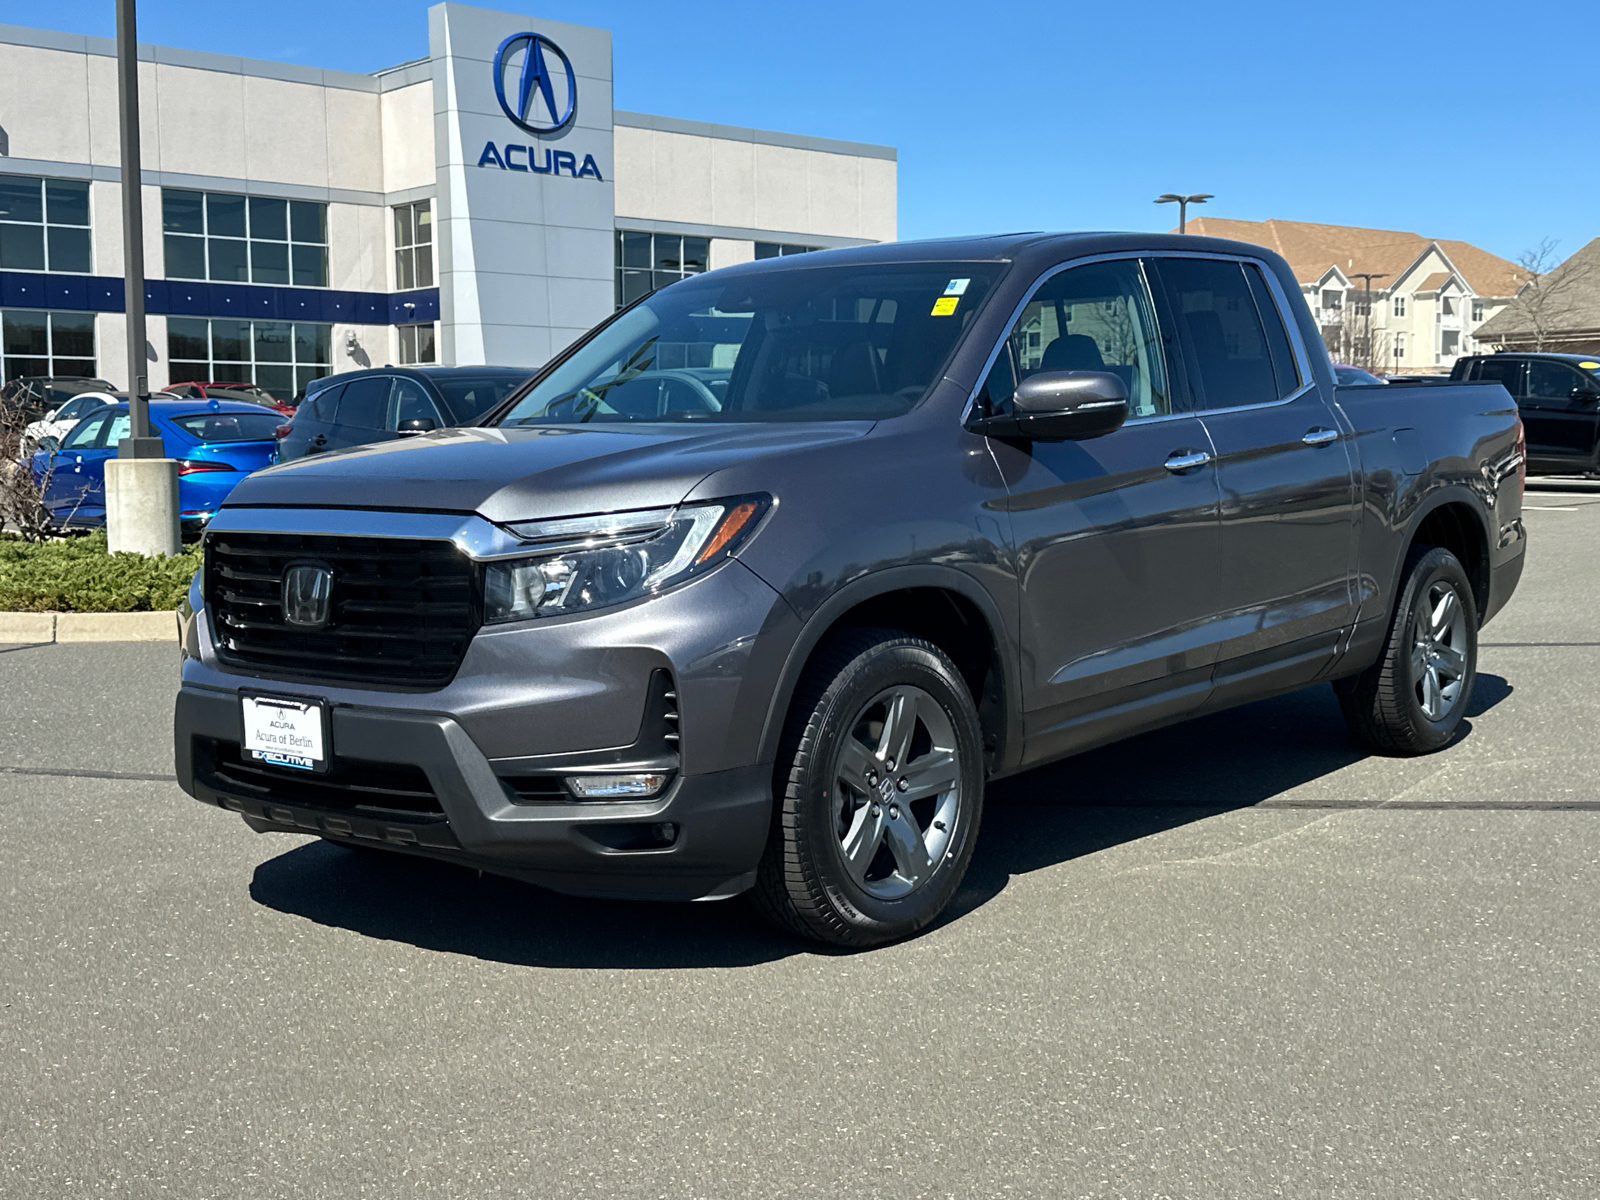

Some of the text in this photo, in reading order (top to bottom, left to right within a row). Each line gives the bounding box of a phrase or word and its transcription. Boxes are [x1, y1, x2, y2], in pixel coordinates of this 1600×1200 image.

[477, 141, 604, 182] ACURA
[256, 333, 307, 345] ACUA
[269, 720, 296, 731] ACURA
[255, 729, 314, 749] Acura of Berlin
[252, 750, 313, 767] EXECUTIVE
